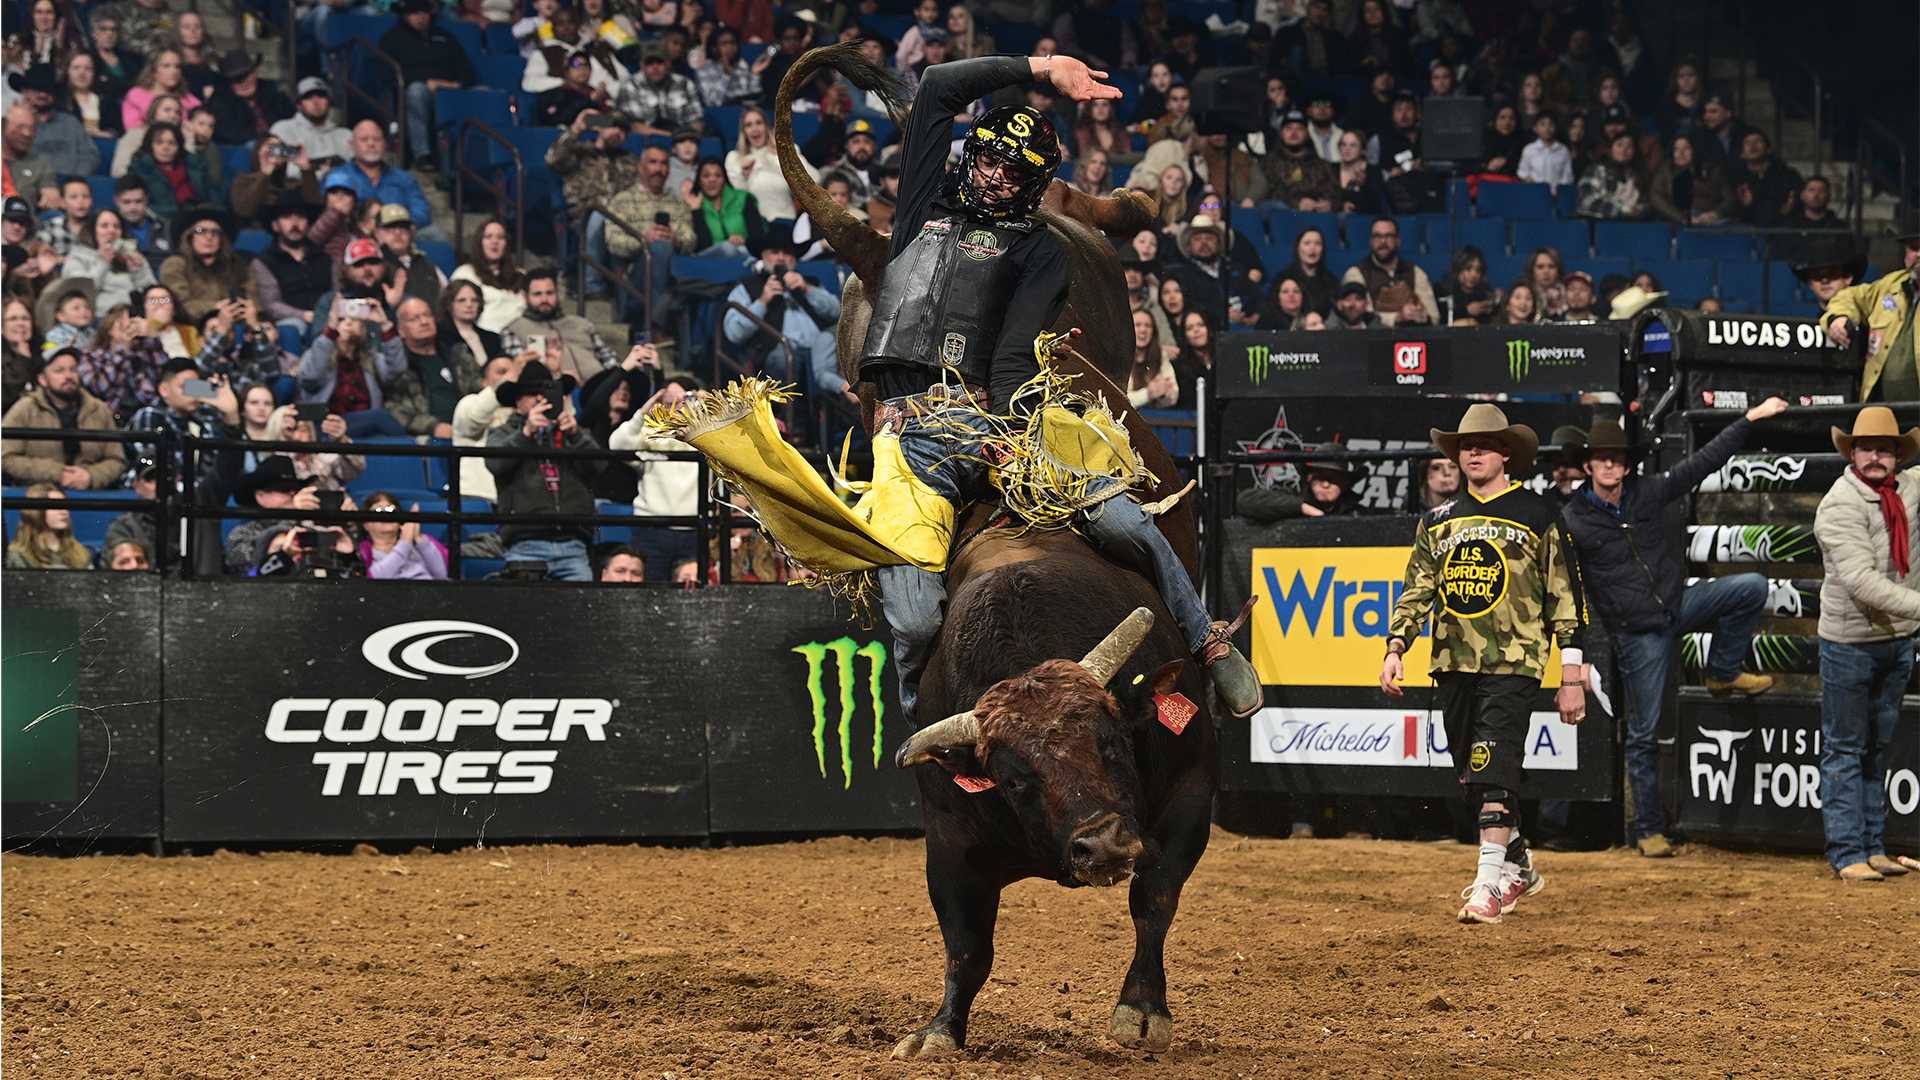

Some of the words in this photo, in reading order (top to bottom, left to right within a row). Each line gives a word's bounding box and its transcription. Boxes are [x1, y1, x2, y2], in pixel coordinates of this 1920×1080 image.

[1708, 320, 1791, 348] LUCAS
[1396, 346, 1422, 369] QT
[1505, 526, 1528, 545] BY
[1460, 547, 1484, 562] U.S.
[1444, 564, 1499, 582] BORDER
[1446, 580, 1495, 598] PATROL
[264, 697, 613, 743] COOPER
[1269, 719, 1397, 754] Michelob
[1760, 728, 1821, 756] VISI
[312, 750, 559, 796] TIRES
[1753, 762, 1823, 809] FOR
